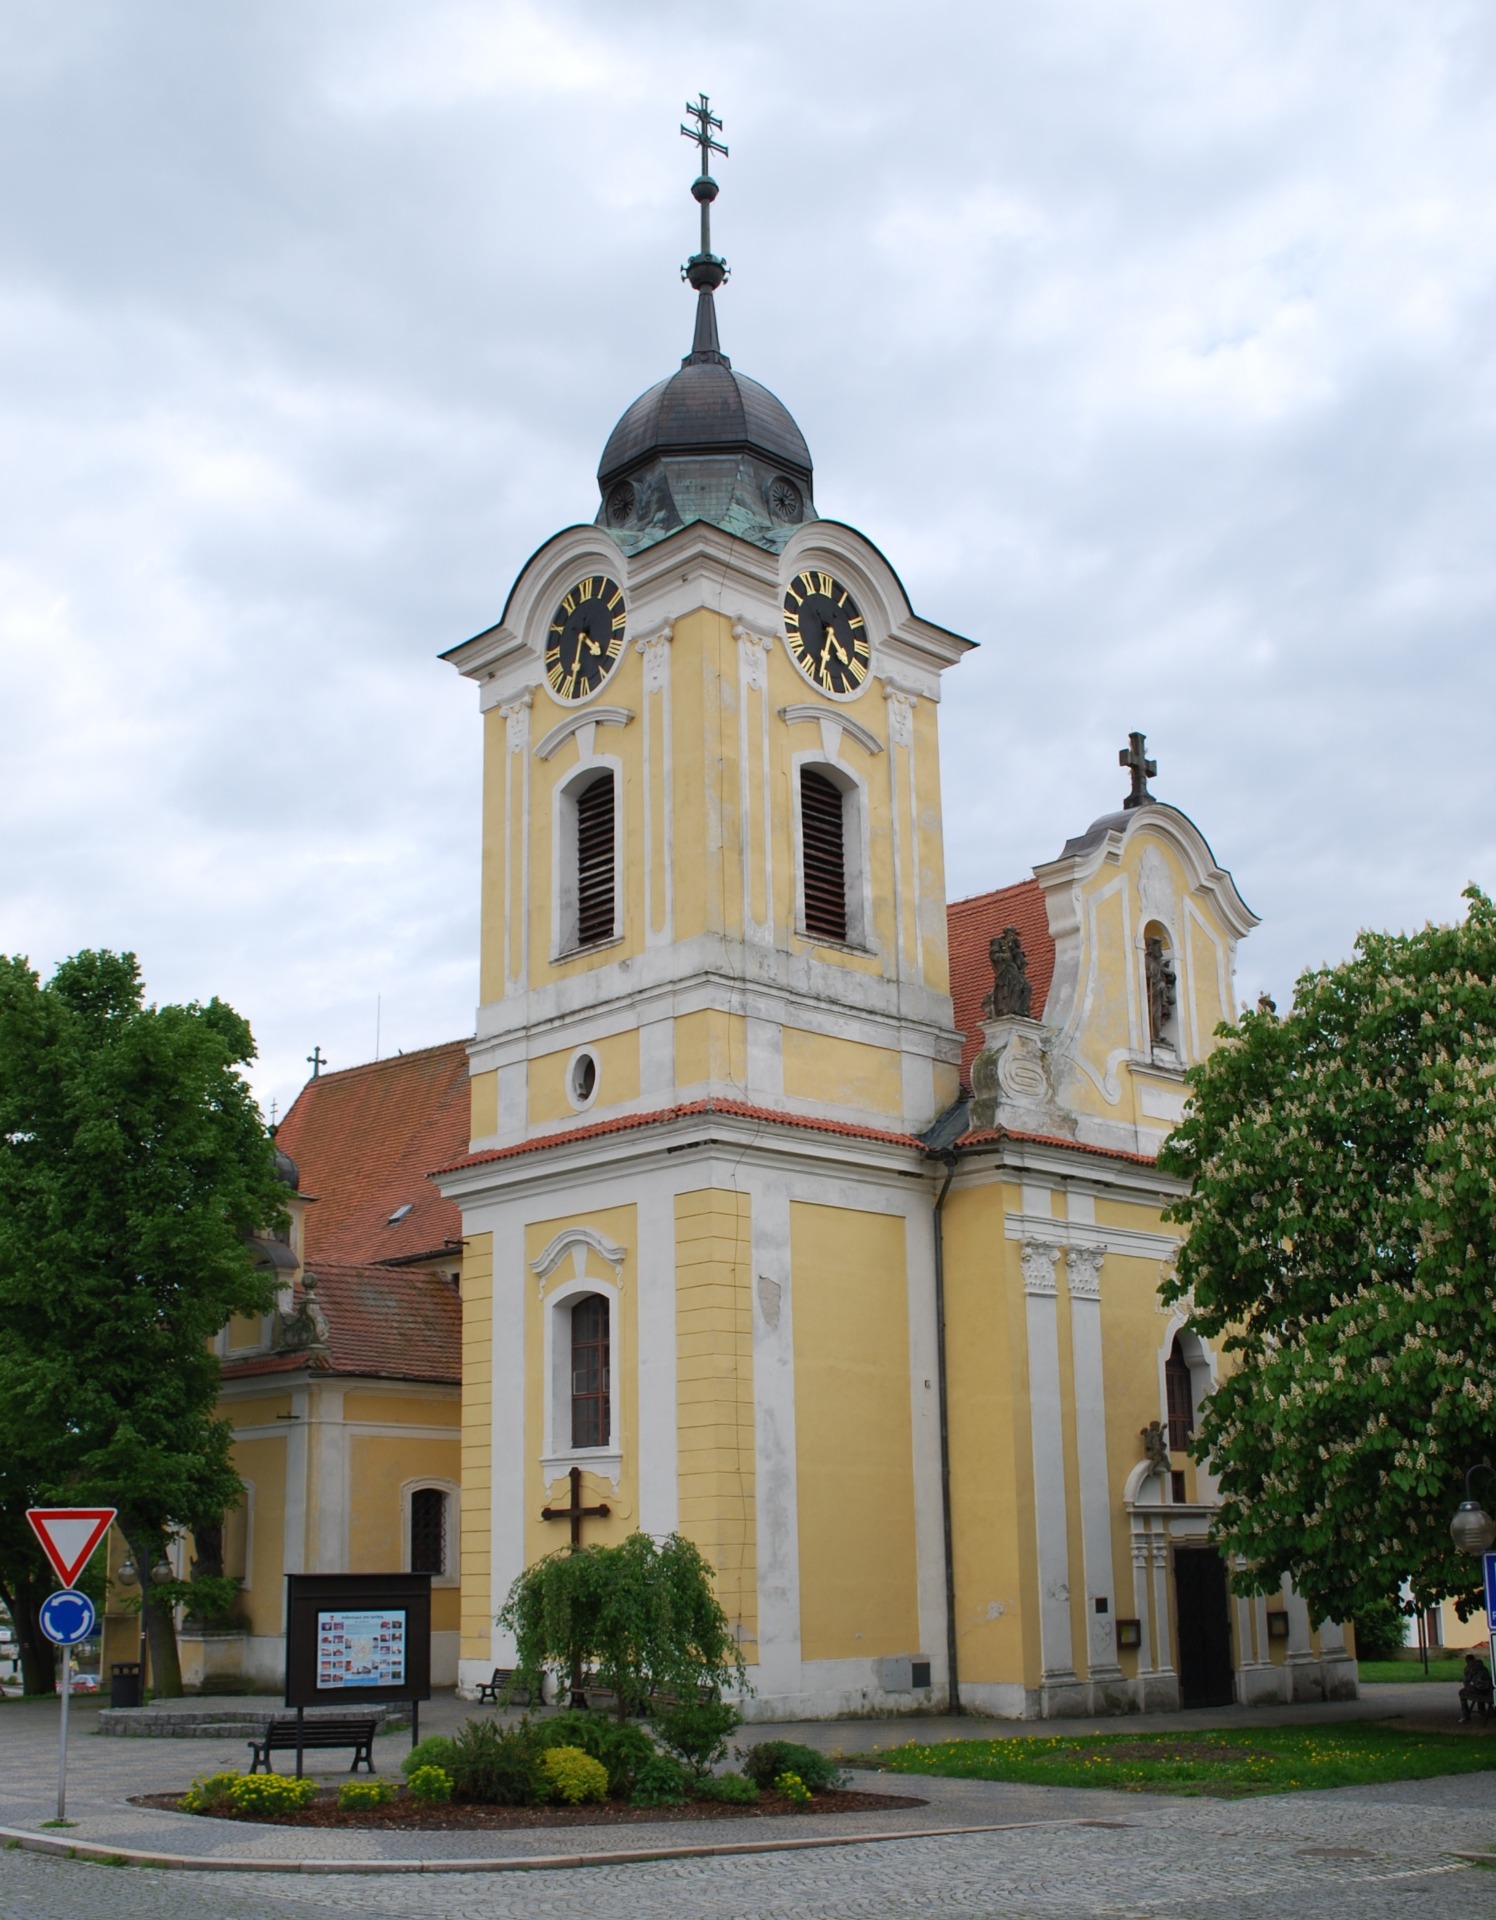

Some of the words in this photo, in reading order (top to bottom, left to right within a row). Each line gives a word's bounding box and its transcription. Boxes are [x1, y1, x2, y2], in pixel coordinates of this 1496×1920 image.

[579, 578, 593, 603] XII
[598, 577, 607, 598] I
[799, 572, 816, 596] XI
[818, 572, 833, 598] XII
[562, 593, 576, 616] XI
[607, 588, 622, 610] II
[787, 584, 804, 606] X
[838, 591, 848, 608] I
[612, 613, 626, 630] III
[783, 608, 799, 627] IX
[848, 616, 864, 630] II
[550, 623, 564, 634] X
[546, 645, 560, 664] IX
[606, 639, 622, 659] IIII
[787, 632, 804, 658] VIII
[854, 639, 869, 658] III
[548, 662, 563, 690] VIII
[801, 653, 816, 680] VII
[848, 657, 867, 684] IIII
[580, 677, 590, 698] VI
[841, 672, 852, 693] V
